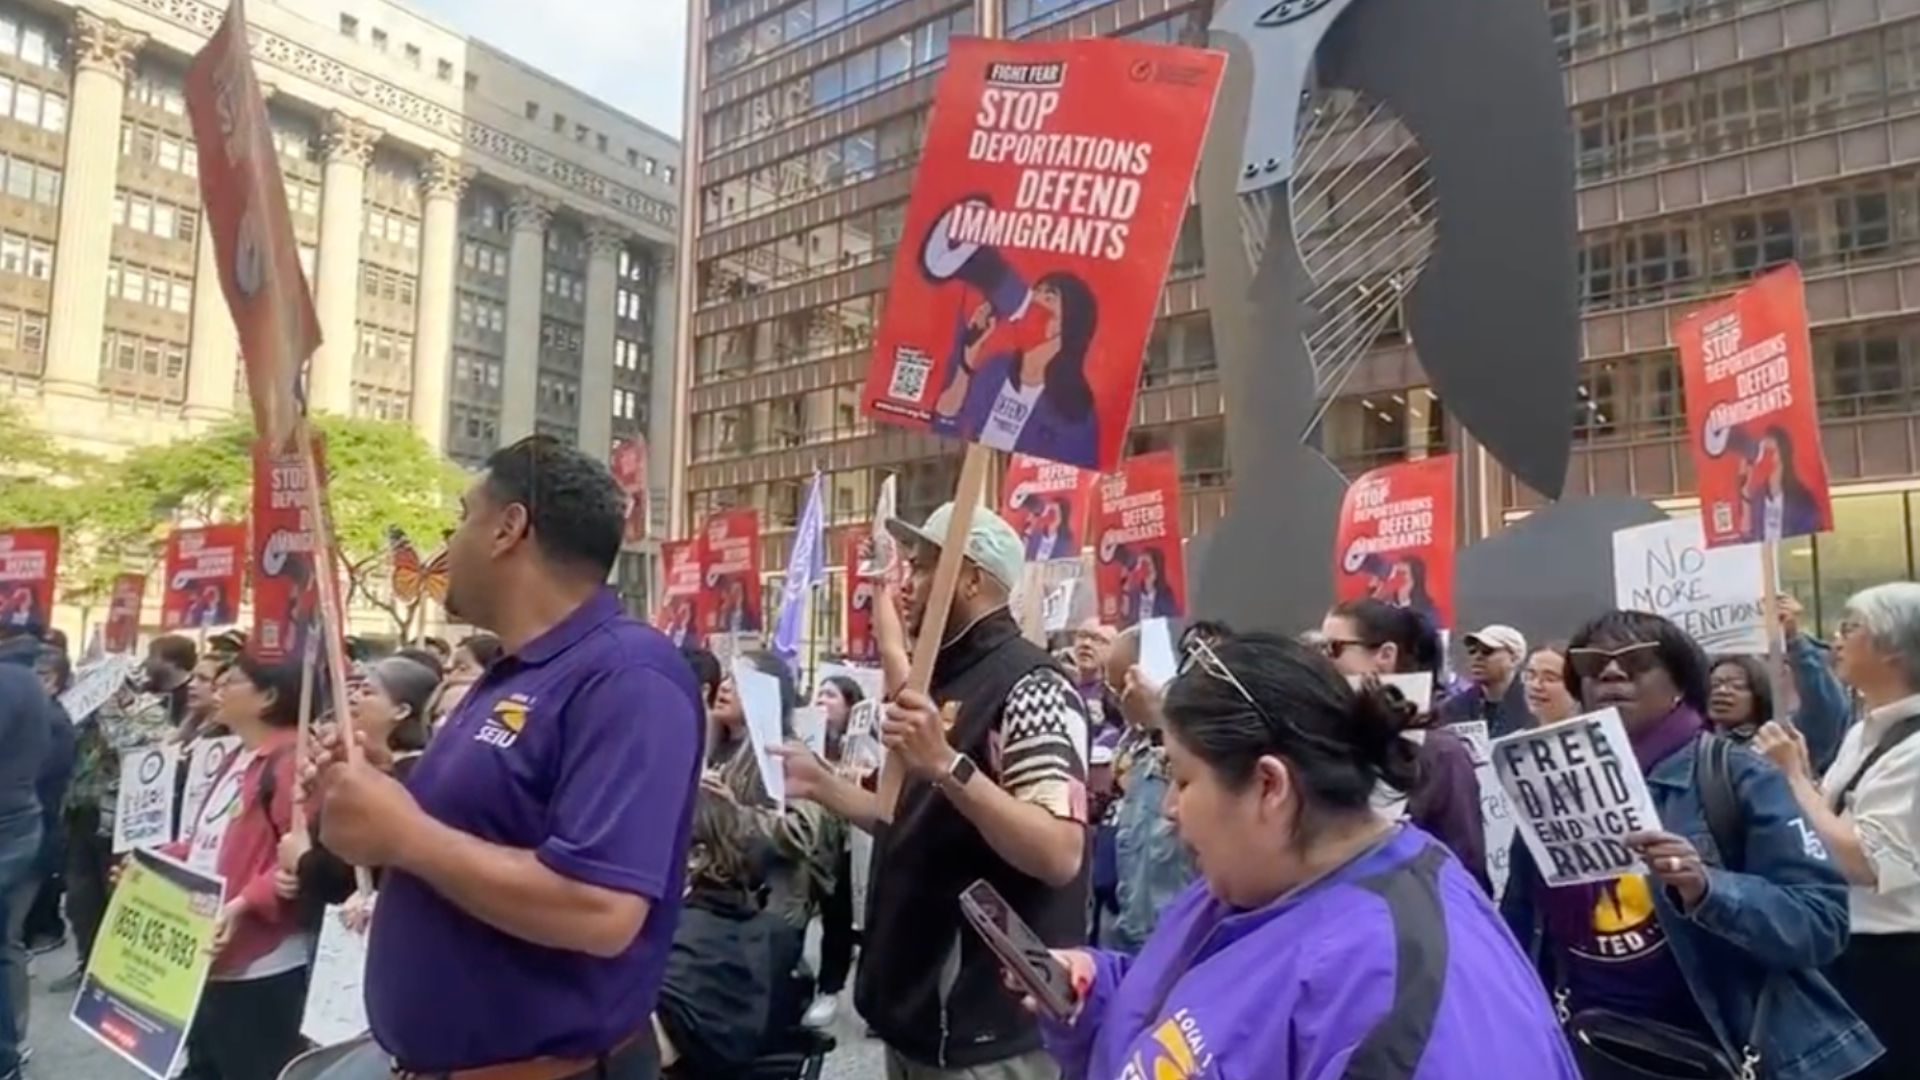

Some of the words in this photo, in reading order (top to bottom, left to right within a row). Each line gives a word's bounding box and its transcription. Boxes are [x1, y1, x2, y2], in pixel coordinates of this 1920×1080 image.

[991, 63, 1028, 82] FIGHT
[1029, 64, 1061, 82] FEAR
[976, 88, 1059, 131] STOP
[968, 130, 1152, 175] DEPORTATIONS
[1015, 169, 1141, 220] DEFEND
[948, 203, 1130, 260] IMMIGRANTS
[1702, 328, 1742, 363] STOP
[1736, 355, 1790, 398] DEFEND
[1378, 511, 1433, 535] DEFEND
[1647, 538, 1705, 584] NO
[1632, 577, 1712, 614] MORE
[473, 725, 518, 749] SEIU
[1502, 721, 1614, 777] FREE
[1516, 760, 1630, 819] DAVID
[1534, 818, 1584, 843] END
[1594, 807, 1643, 835] ICE
